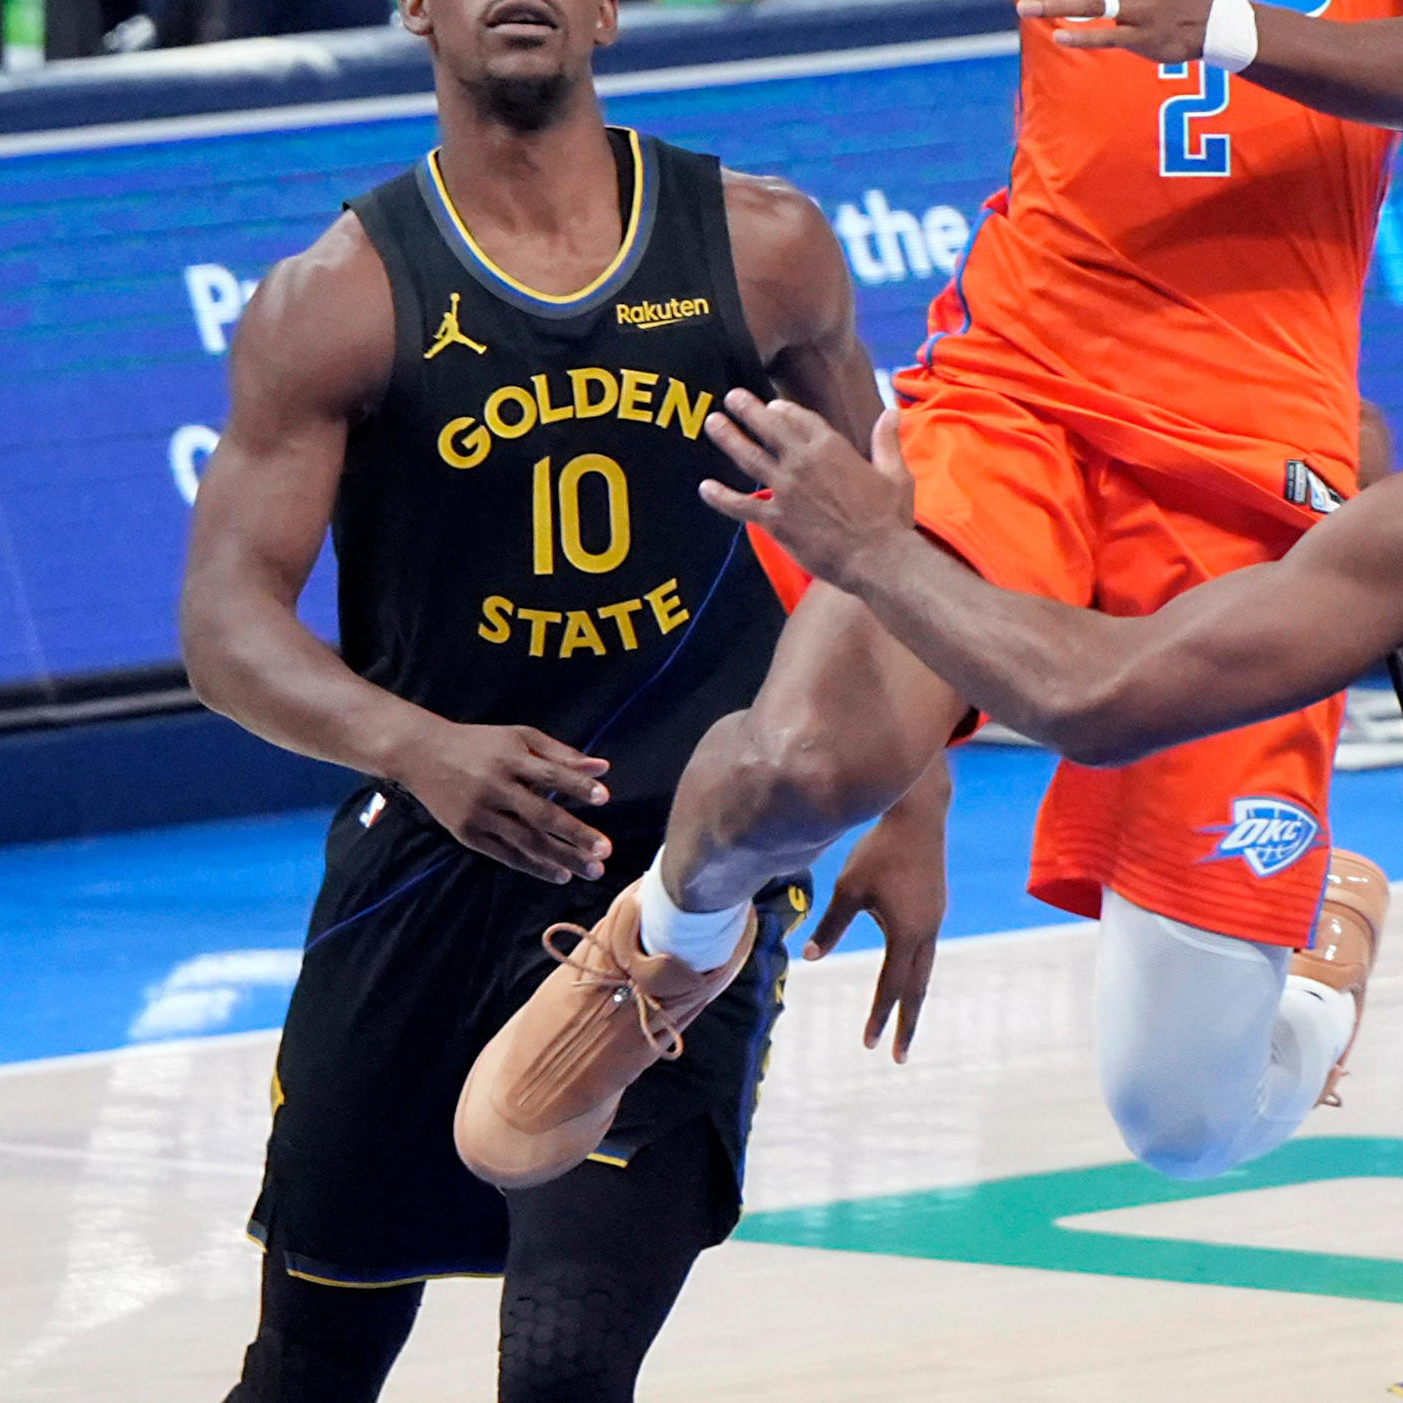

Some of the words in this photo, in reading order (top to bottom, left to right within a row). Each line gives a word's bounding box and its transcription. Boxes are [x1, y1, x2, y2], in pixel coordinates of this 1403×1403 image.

[1158, 60, 1231, 177] 2
[836, 189, 970, 284] the
[616, 297, 710, 328] Rakuten
[437, 366, 714, 469] GOLDEN
[532, 453, 631, 576] 10
[477, 577, 691, 659] STATE
[1219, 817, 1303, 850] OKC
